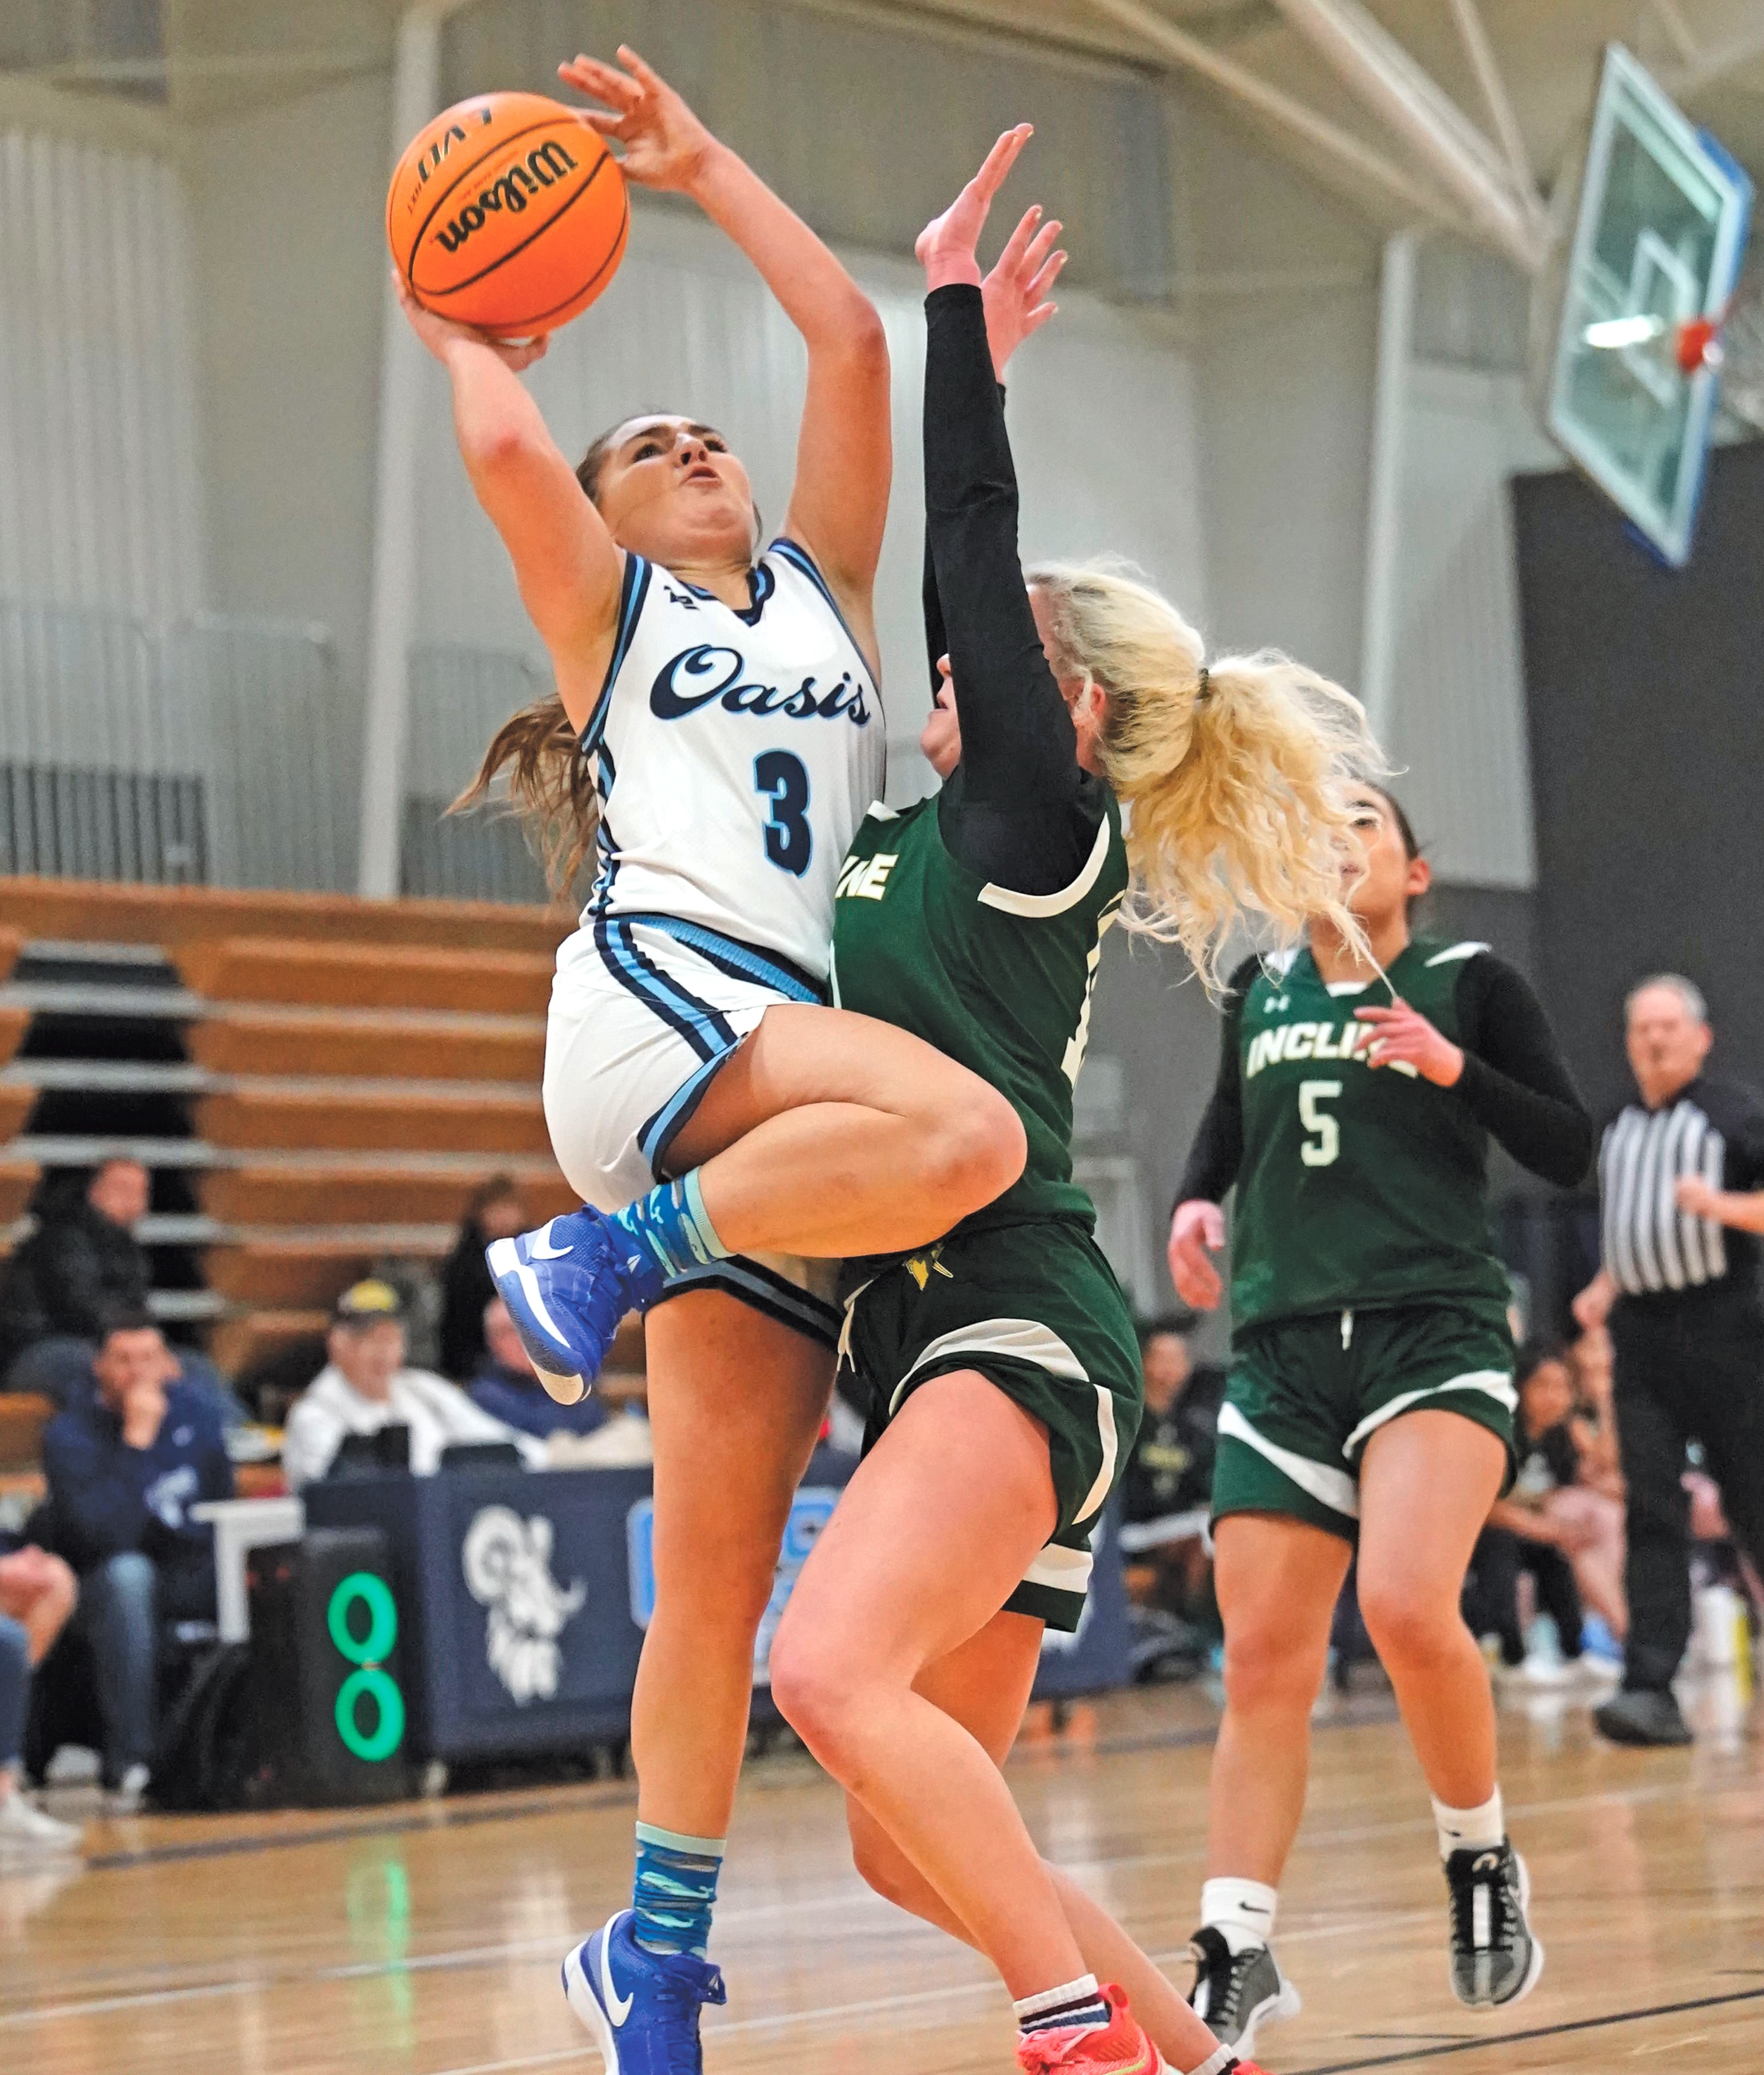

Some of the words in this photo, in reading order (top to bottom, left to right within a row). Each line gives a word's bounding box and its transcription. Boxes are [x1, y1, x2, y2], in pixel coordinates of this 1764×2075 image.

[435, 140, 578, 252] Wilson
[650, 644, 870, 728] Oasis
[753, 748, 814, 879] 3
[1299, 1080, 1343, 1167] 5
